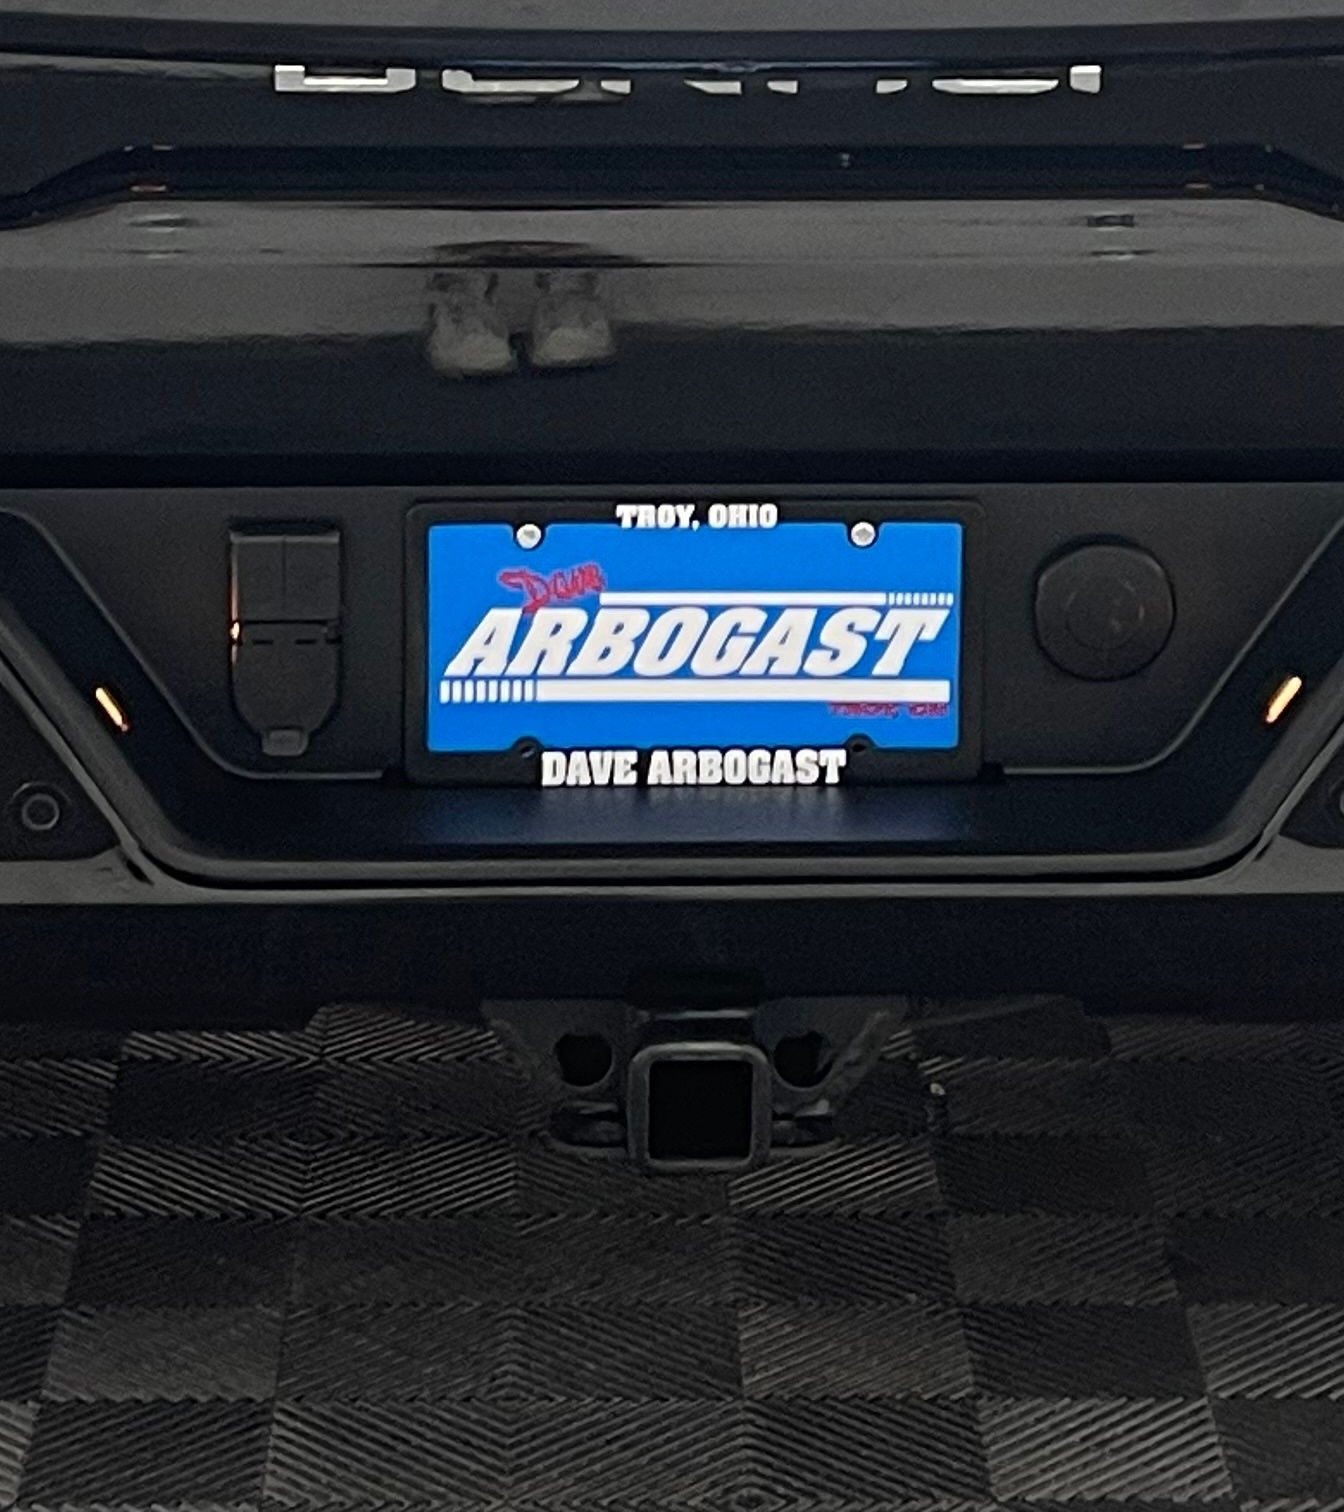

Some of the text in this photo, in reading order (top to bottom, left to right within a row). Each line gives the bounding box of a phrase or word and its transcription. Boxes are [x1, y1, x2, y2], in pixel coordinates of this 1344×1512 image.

[616, 503, 778, 530] TROY, OHIO
[444, 606, 949, 676] ARBOGAST
[541, 748, 847, 786] DAVE ARBOGAST
